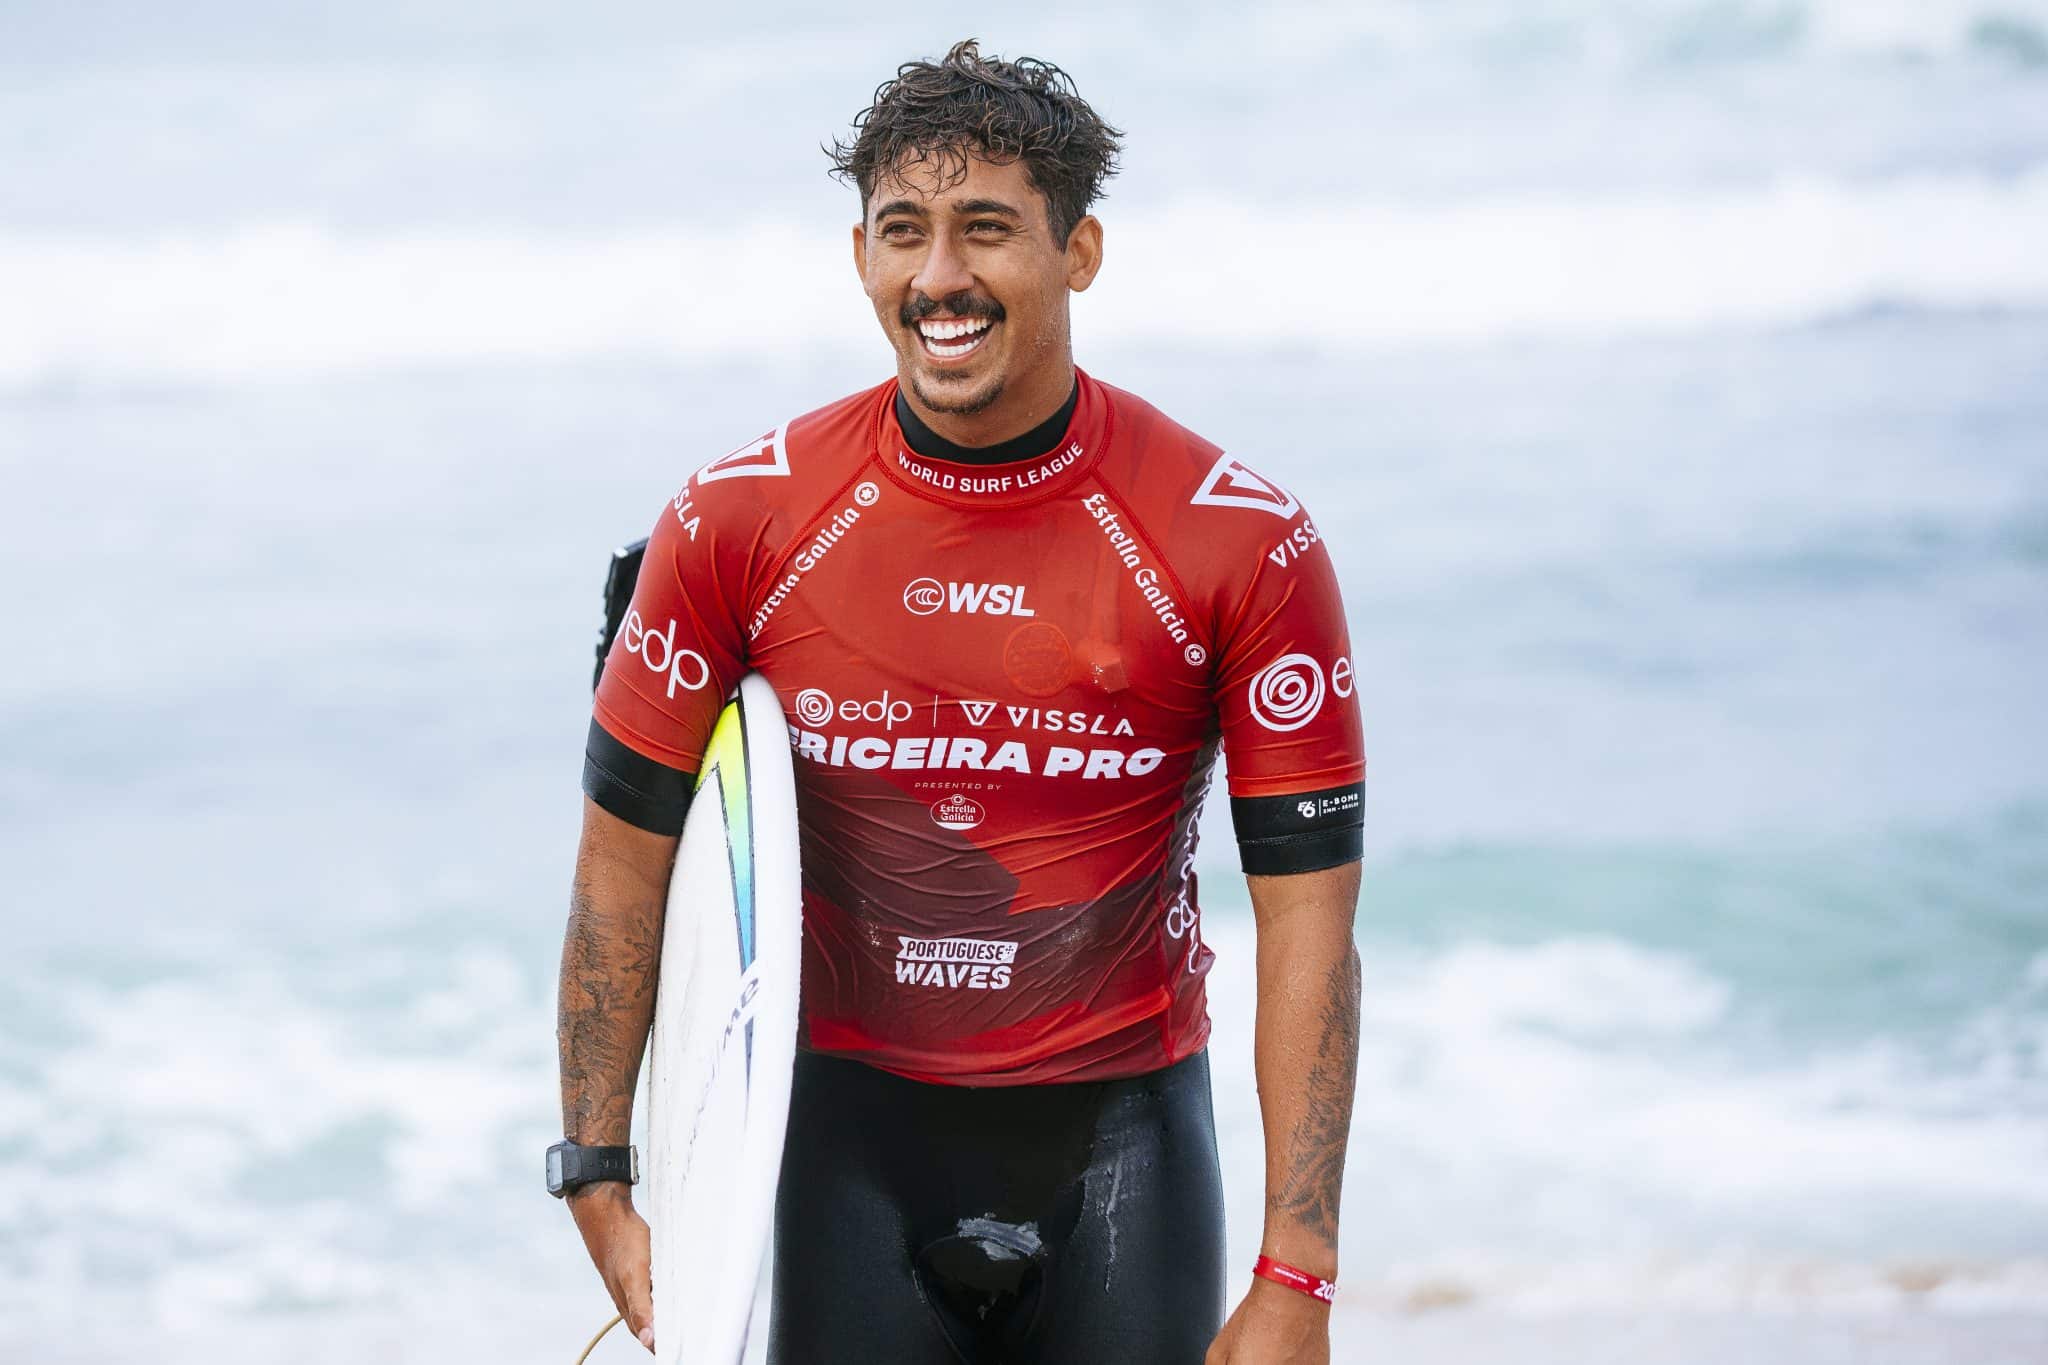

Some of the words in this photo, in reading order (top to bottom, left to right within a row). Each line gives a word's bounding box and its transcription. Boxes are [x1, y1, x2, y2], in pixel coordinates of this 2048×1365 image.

[898, 451, 955, 490] WORLD
[959, 476, 1013, 493] SURF
[1017, 441, 1084, 488] LEAGUE
[673, 484, 701, 542] SLA
[795, 507, 860, 572] Galicia
[1268, 519, 1321, 568] VISS
[1081, 493, 1141, 569] Estrella
[1135, 569, 1188, 644] Galicia
[948, 582, 1035, 617] WSL
[624, 610, 709, 699] edp
[838, 689, 913, 731] edp
[1006, 705, 1136, 737] VISSLA
[1042, 746, 1167, 780] PRO
[914, 781, 982, 790] PRESENTED
[987, 783, 1002, 791] BY
[939, 804, 976, 814] Estrella
[940, 812, 974, 822] Galicia
[906, 940, 1005, 961] PORTUGUESE
[895, 960, 1012, 990] WAVES
[1314, 1279, 1337, 1299] 20
